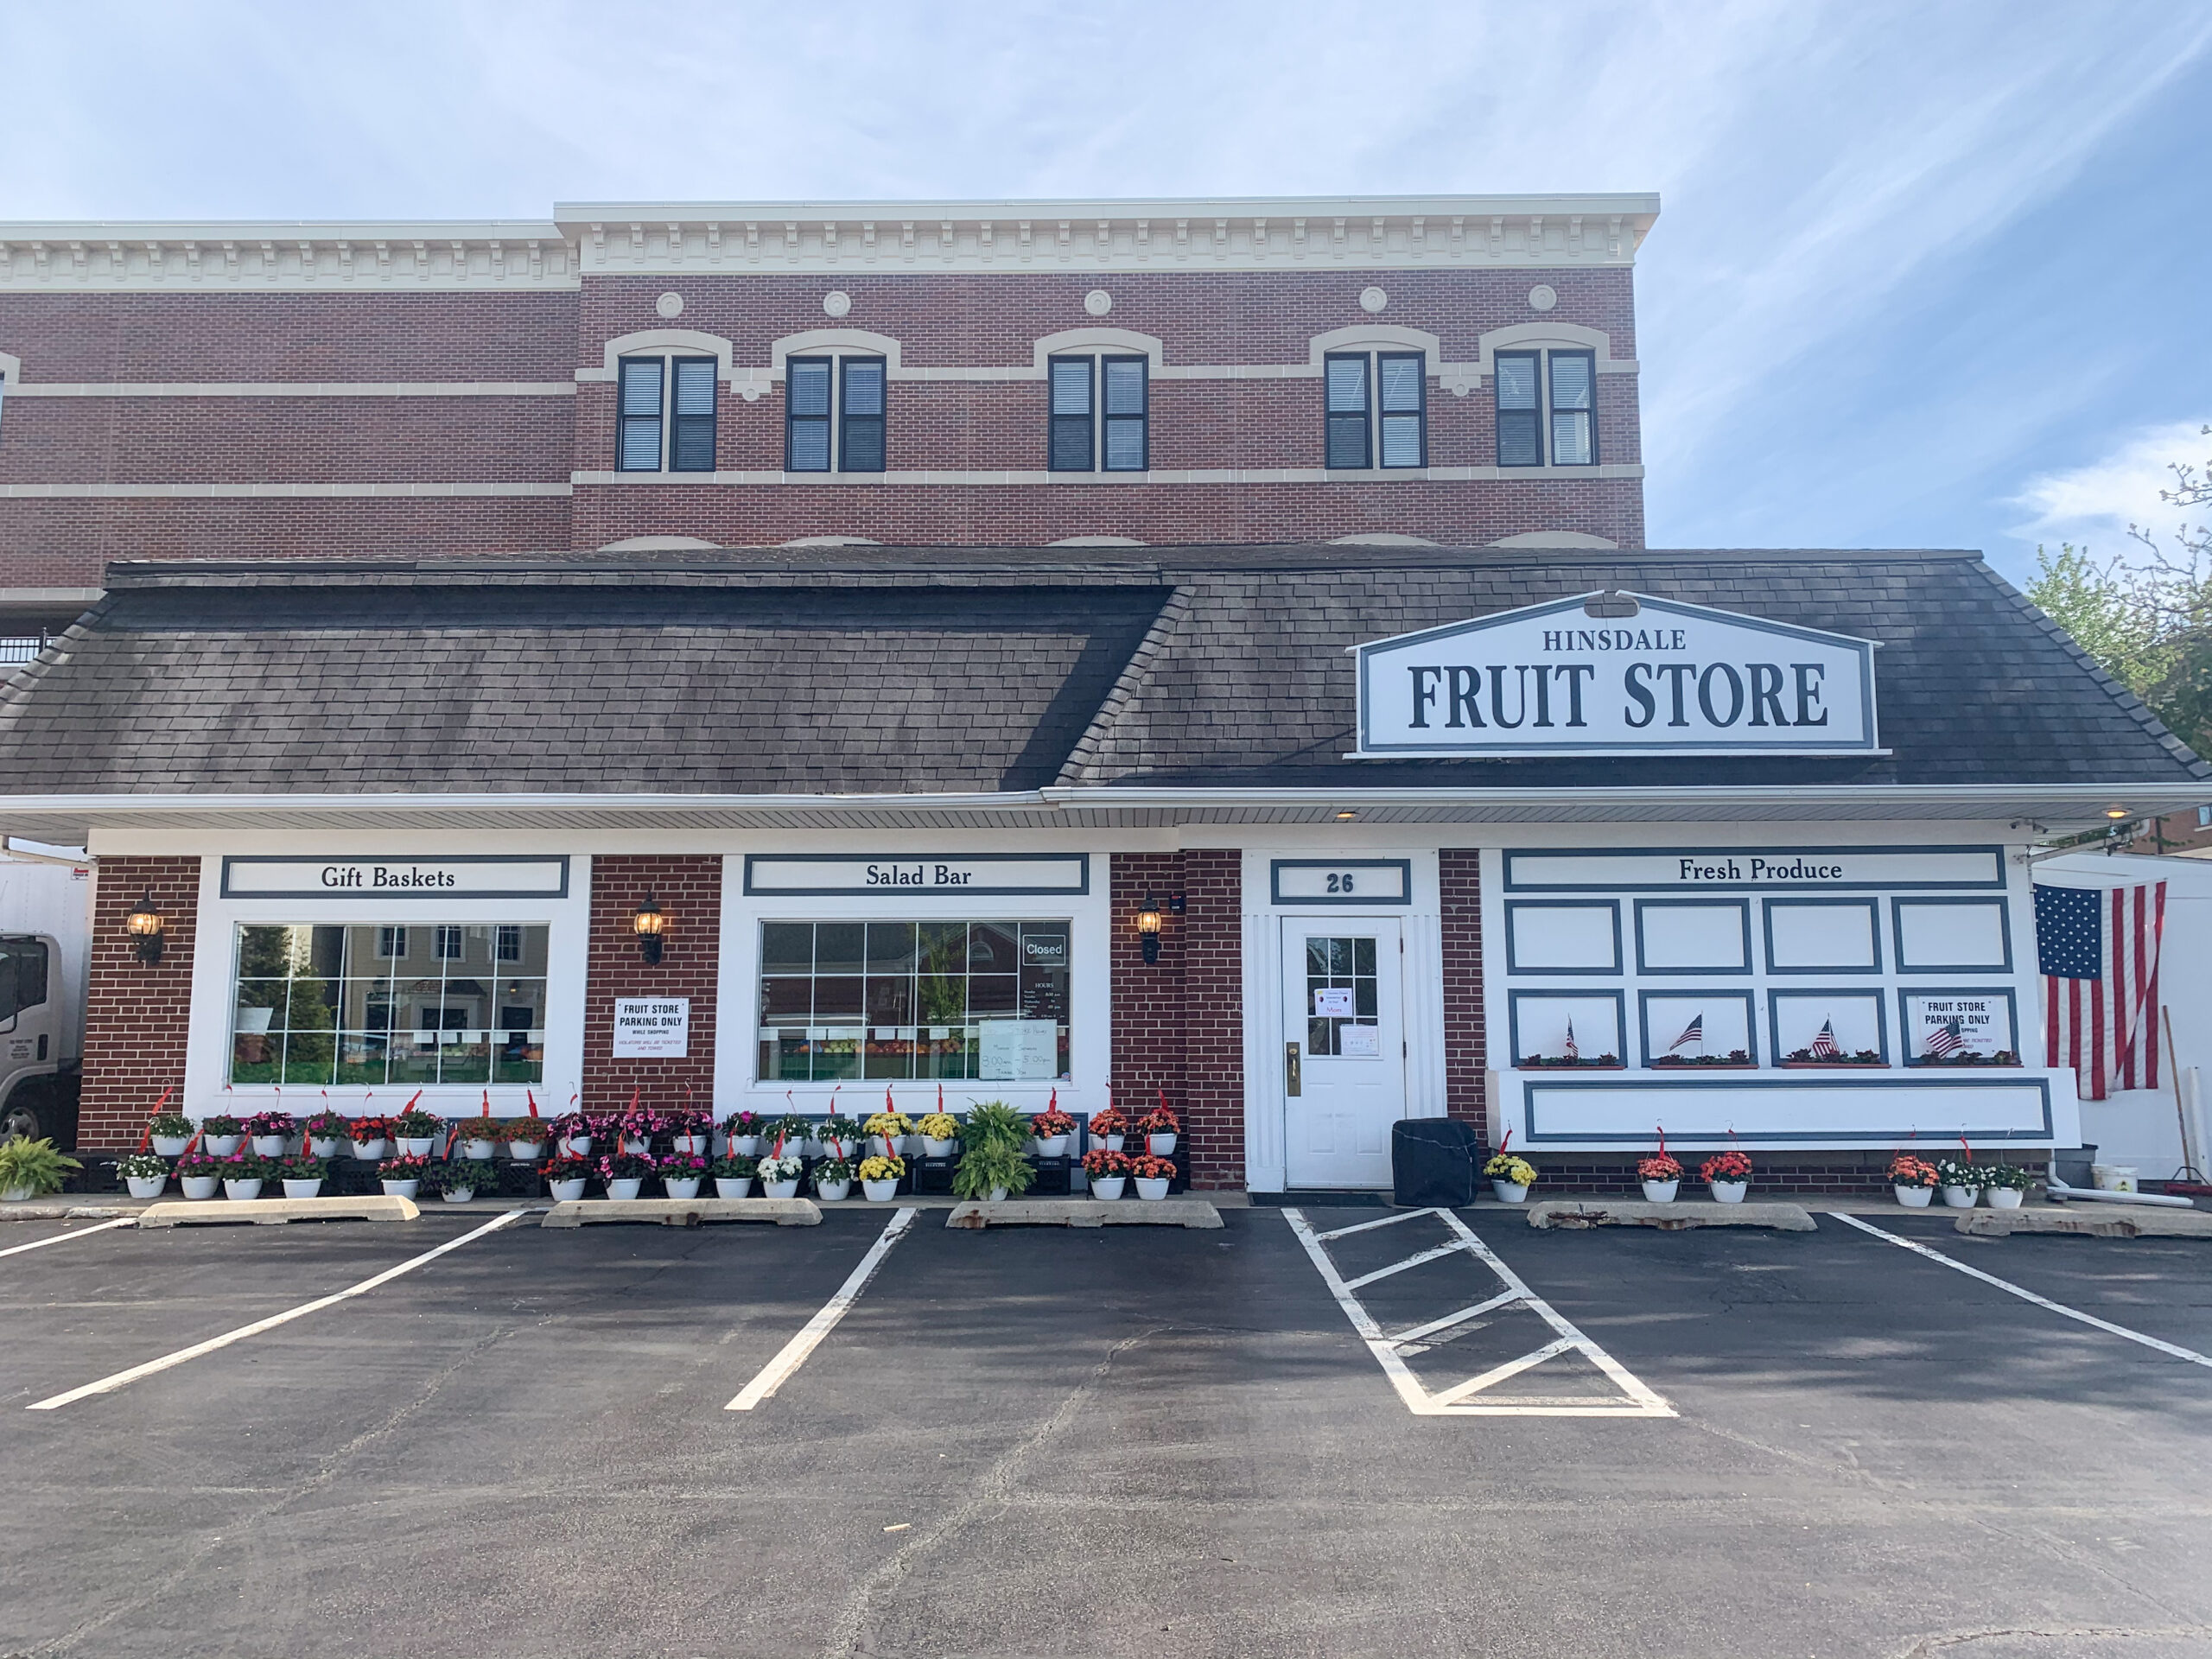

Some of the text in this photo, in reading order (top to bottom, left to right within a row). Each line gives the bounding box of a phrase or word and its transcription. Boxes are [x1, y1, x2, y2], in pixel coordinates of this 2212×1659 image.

[1542, 629, 1686, 652] HINSDALE
[1408, 662, 1828, 729] FRUIT STORE
[321, 867, 455, 887] Gift Baskets
[866, 865, 971, 885] Salad Bar
[1679, 858, 1842, 880] Fresh Produce
[1326, 873, 1354, 893] 26
[1027, 944, 1062, 954] Closed
[624, 1004, 679, 1014] FRUIT STORE
[1928, 1002, 1986, 1011] FRUIT STORE
[620, 1017, 683, 1026] PARKING ONLY
[1925, 1015, 1990, 1025] PARKING ONLY
